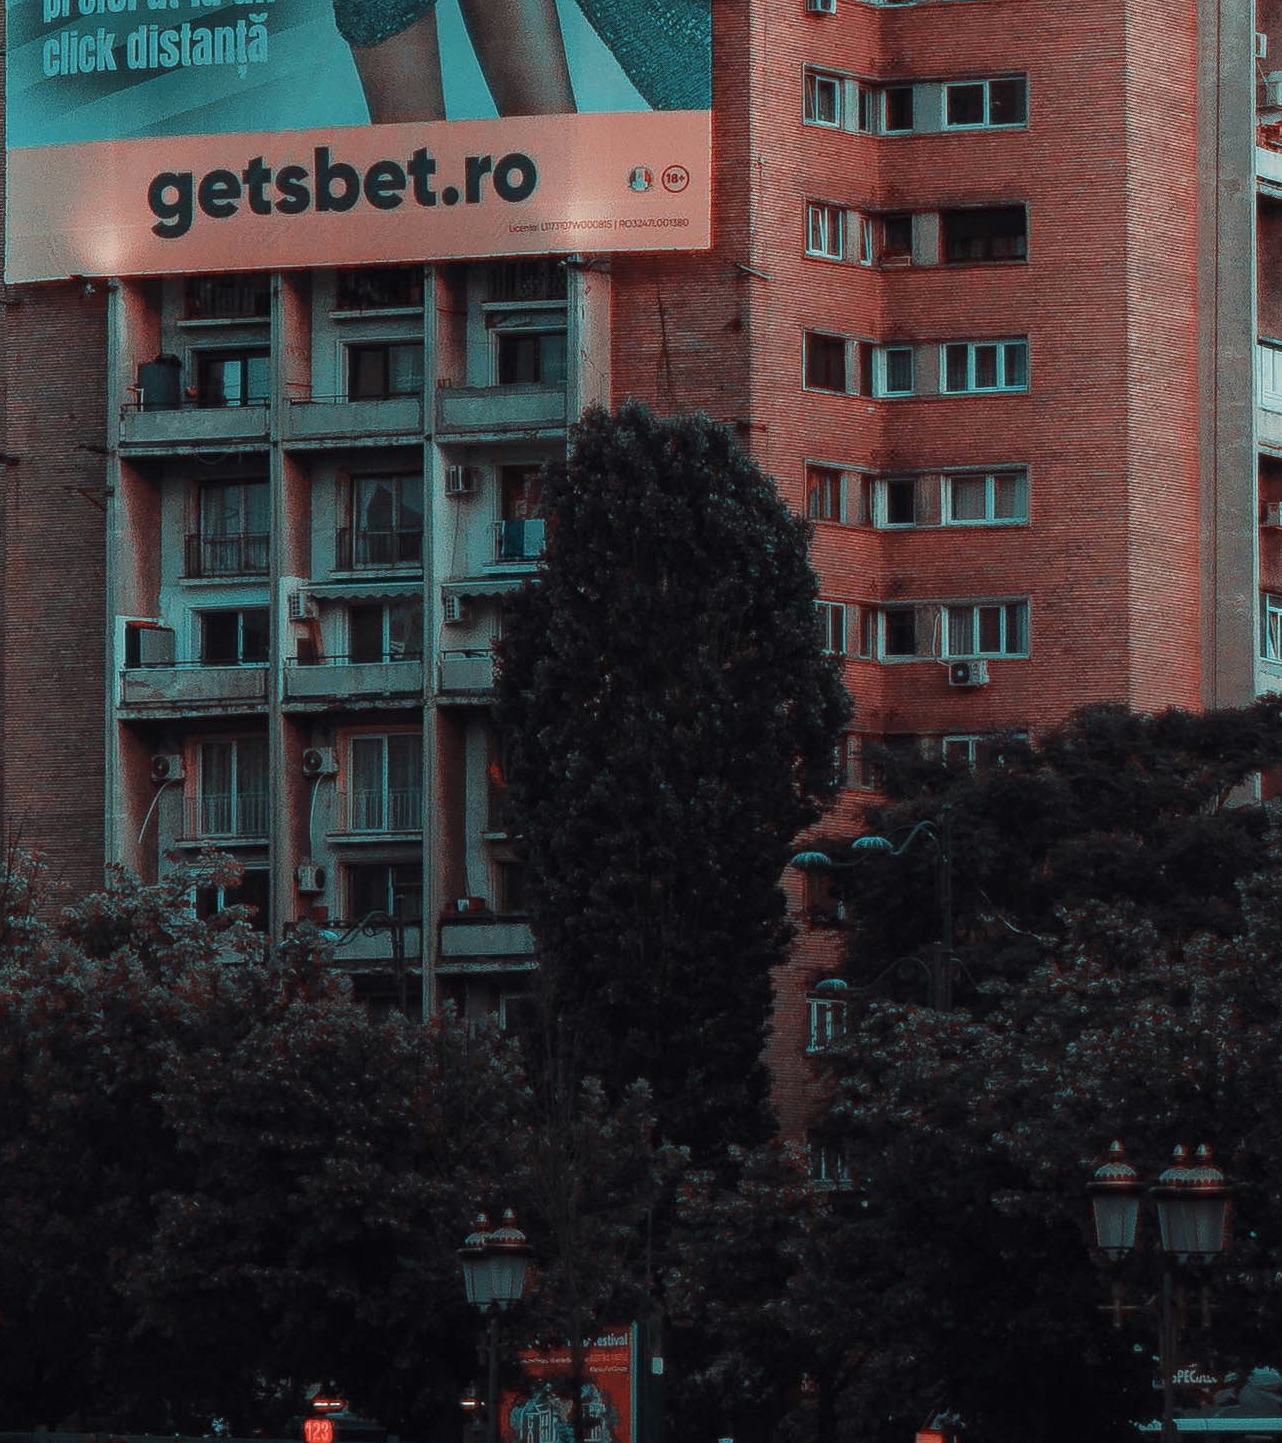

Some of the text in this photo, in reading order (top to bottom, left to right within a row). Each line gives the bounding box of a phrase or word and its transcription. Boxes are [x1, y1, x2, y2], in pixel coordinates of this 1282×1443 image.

[43, 12, 268, 80] click distanță
[147, 146, 538, 239] getsbet.ro
[593, 1332, 628, 1347] estival
